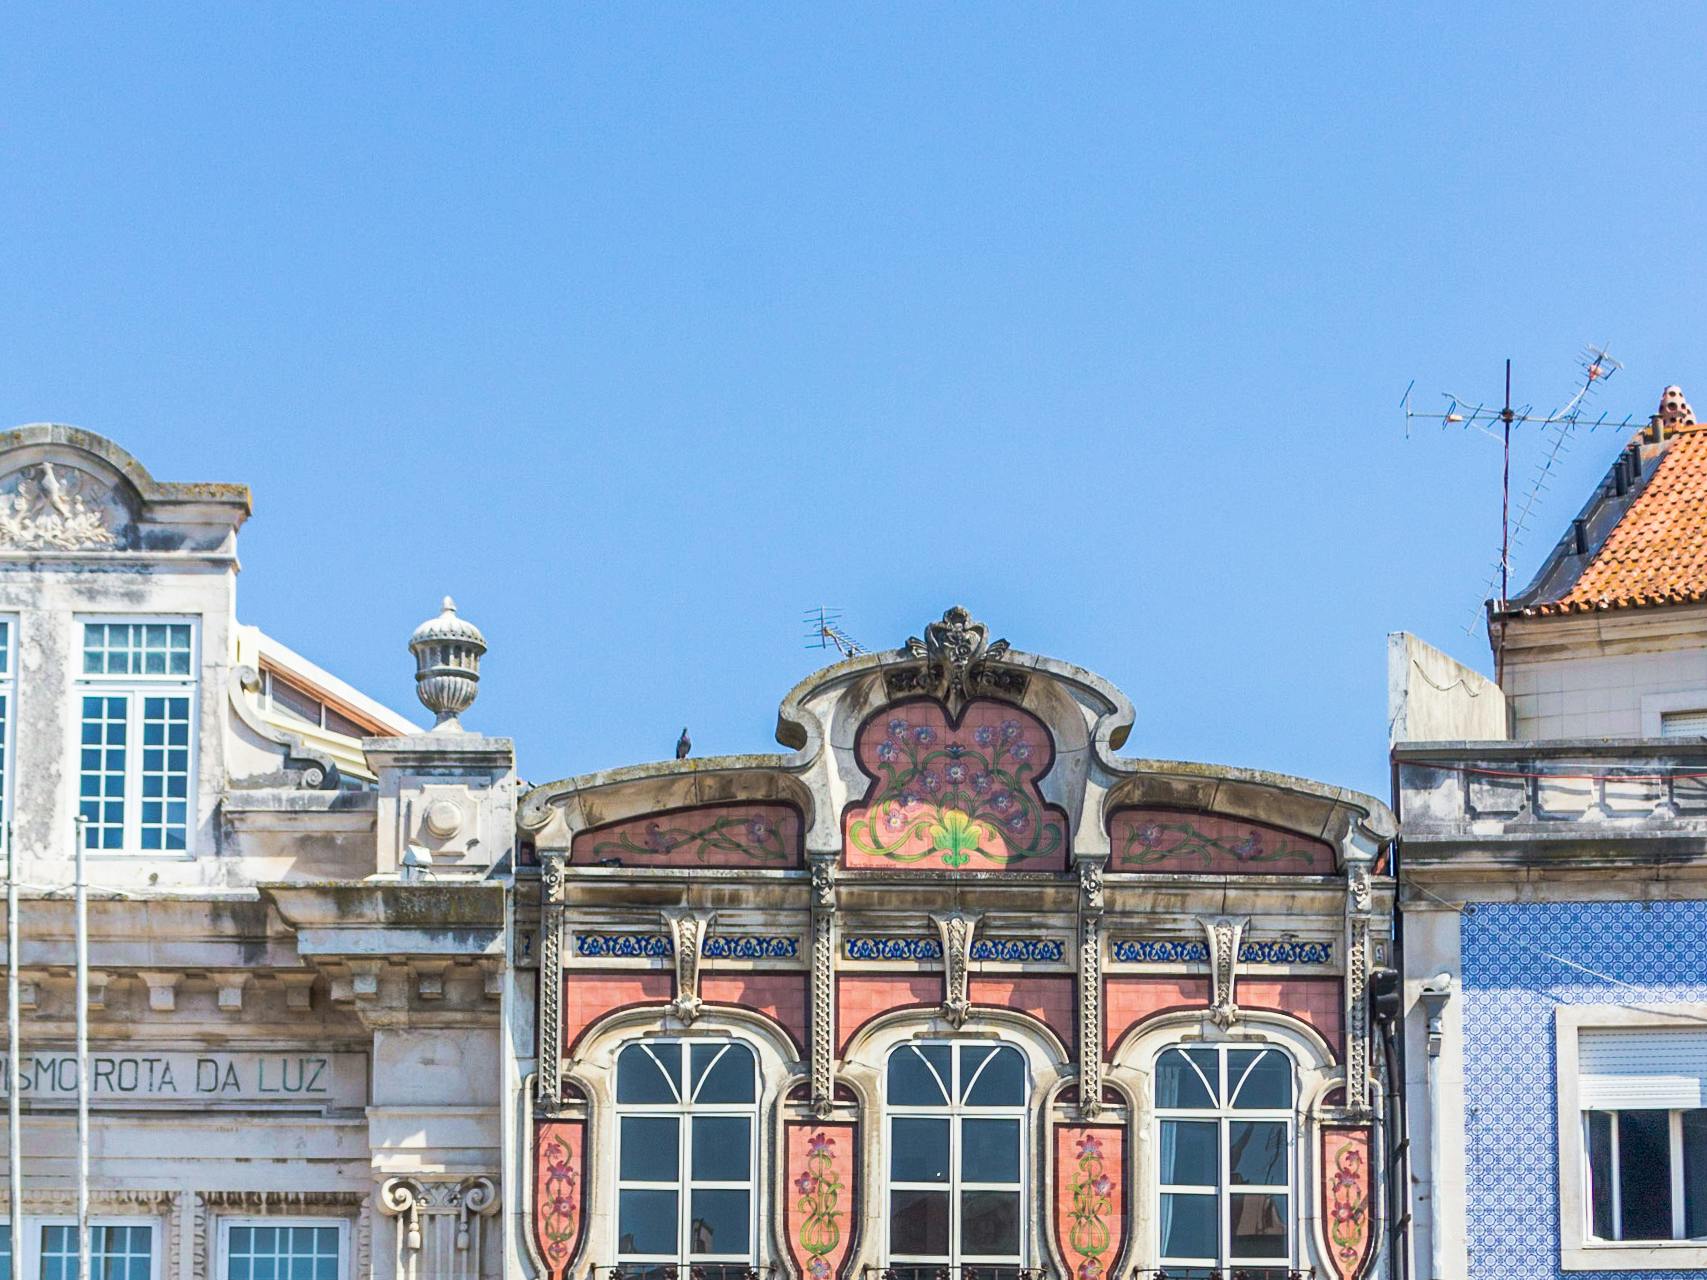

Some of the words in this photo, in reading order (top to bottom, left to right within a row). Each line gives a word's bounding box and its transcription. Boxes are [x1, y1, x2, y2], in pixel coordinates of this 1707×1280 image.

[0, 1058, 78, 1092] ISMO
[94, 1058, 176, 1092] ROTA
[196, 1058, 241, 1092] DA
[258, 1058, 327, 1093] LUZ
